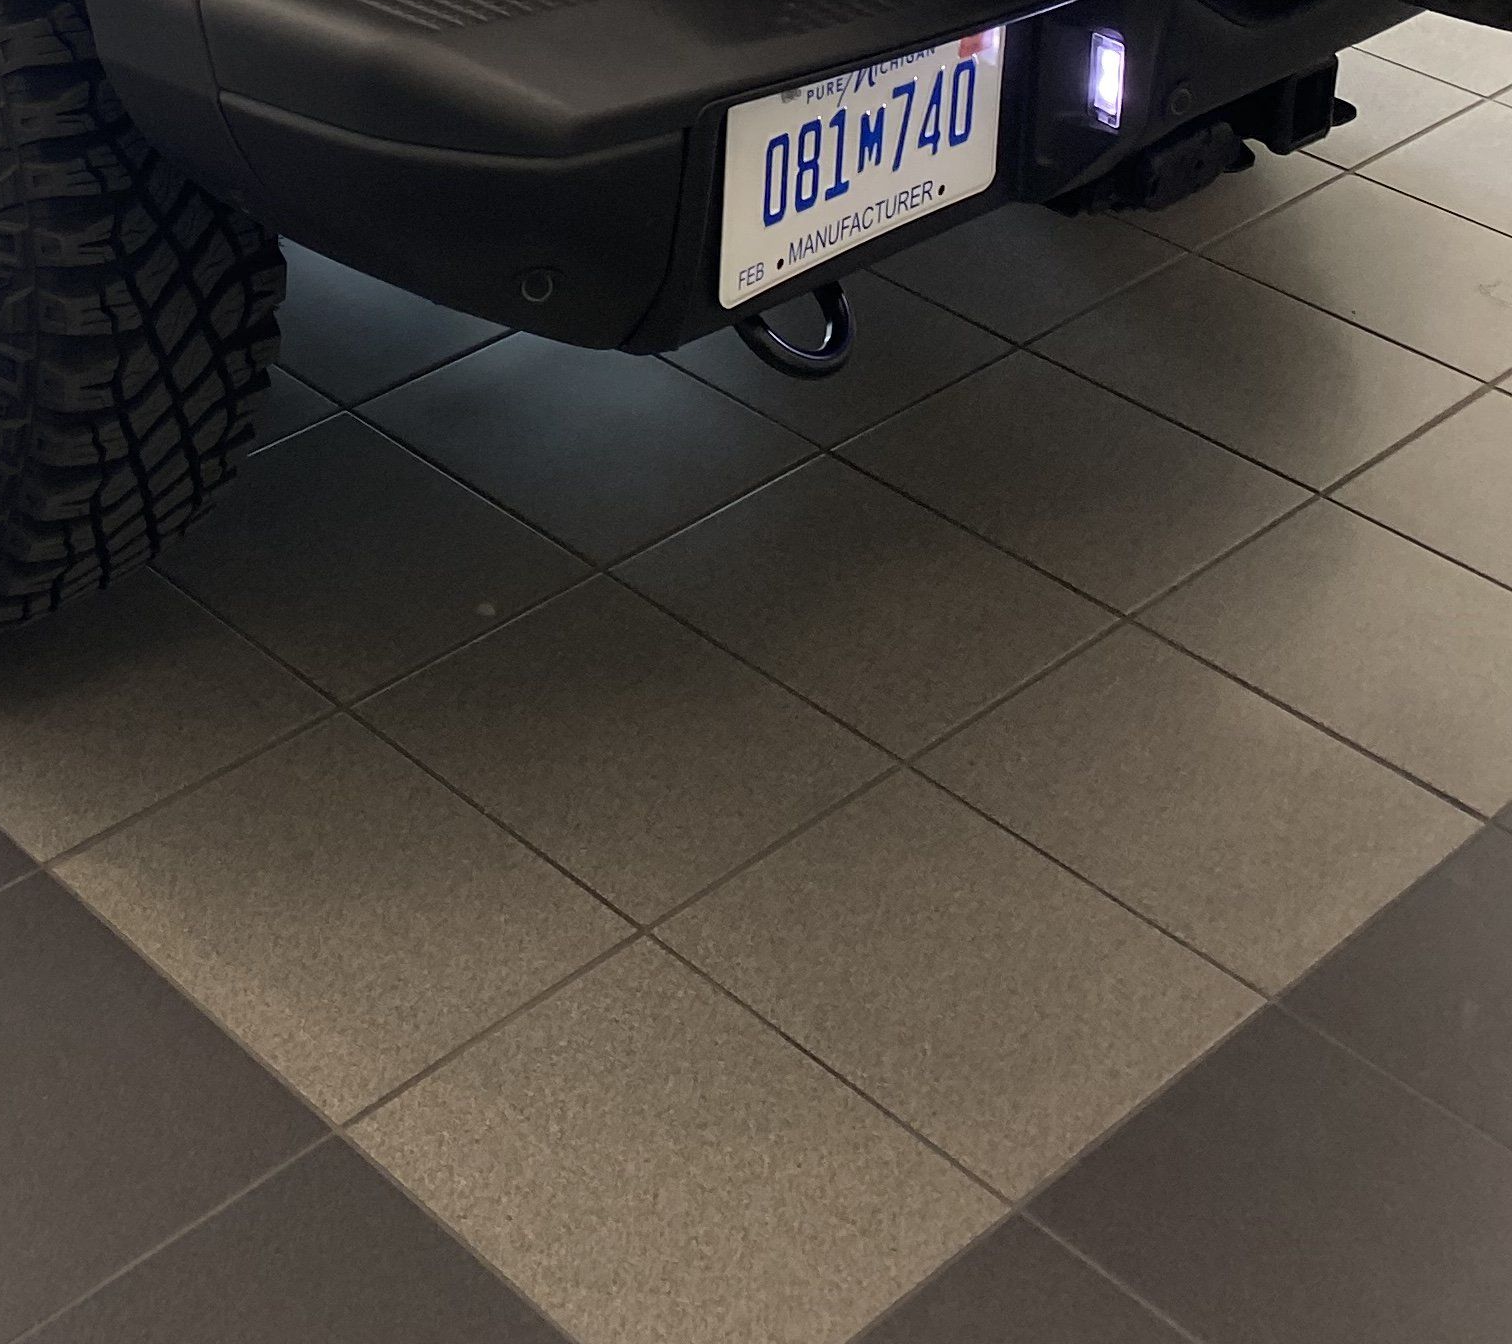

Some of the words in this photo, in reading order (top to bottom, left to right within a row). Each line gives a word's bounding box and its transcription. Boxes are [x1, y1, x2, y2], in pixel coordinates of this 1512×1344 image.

[805, 76, 846, 105] PURE
[763, 55, 977, 228] 081M740
[788, 179, 935, 265] MANUFACTURER
[738, 261, 766, 291] FEB
